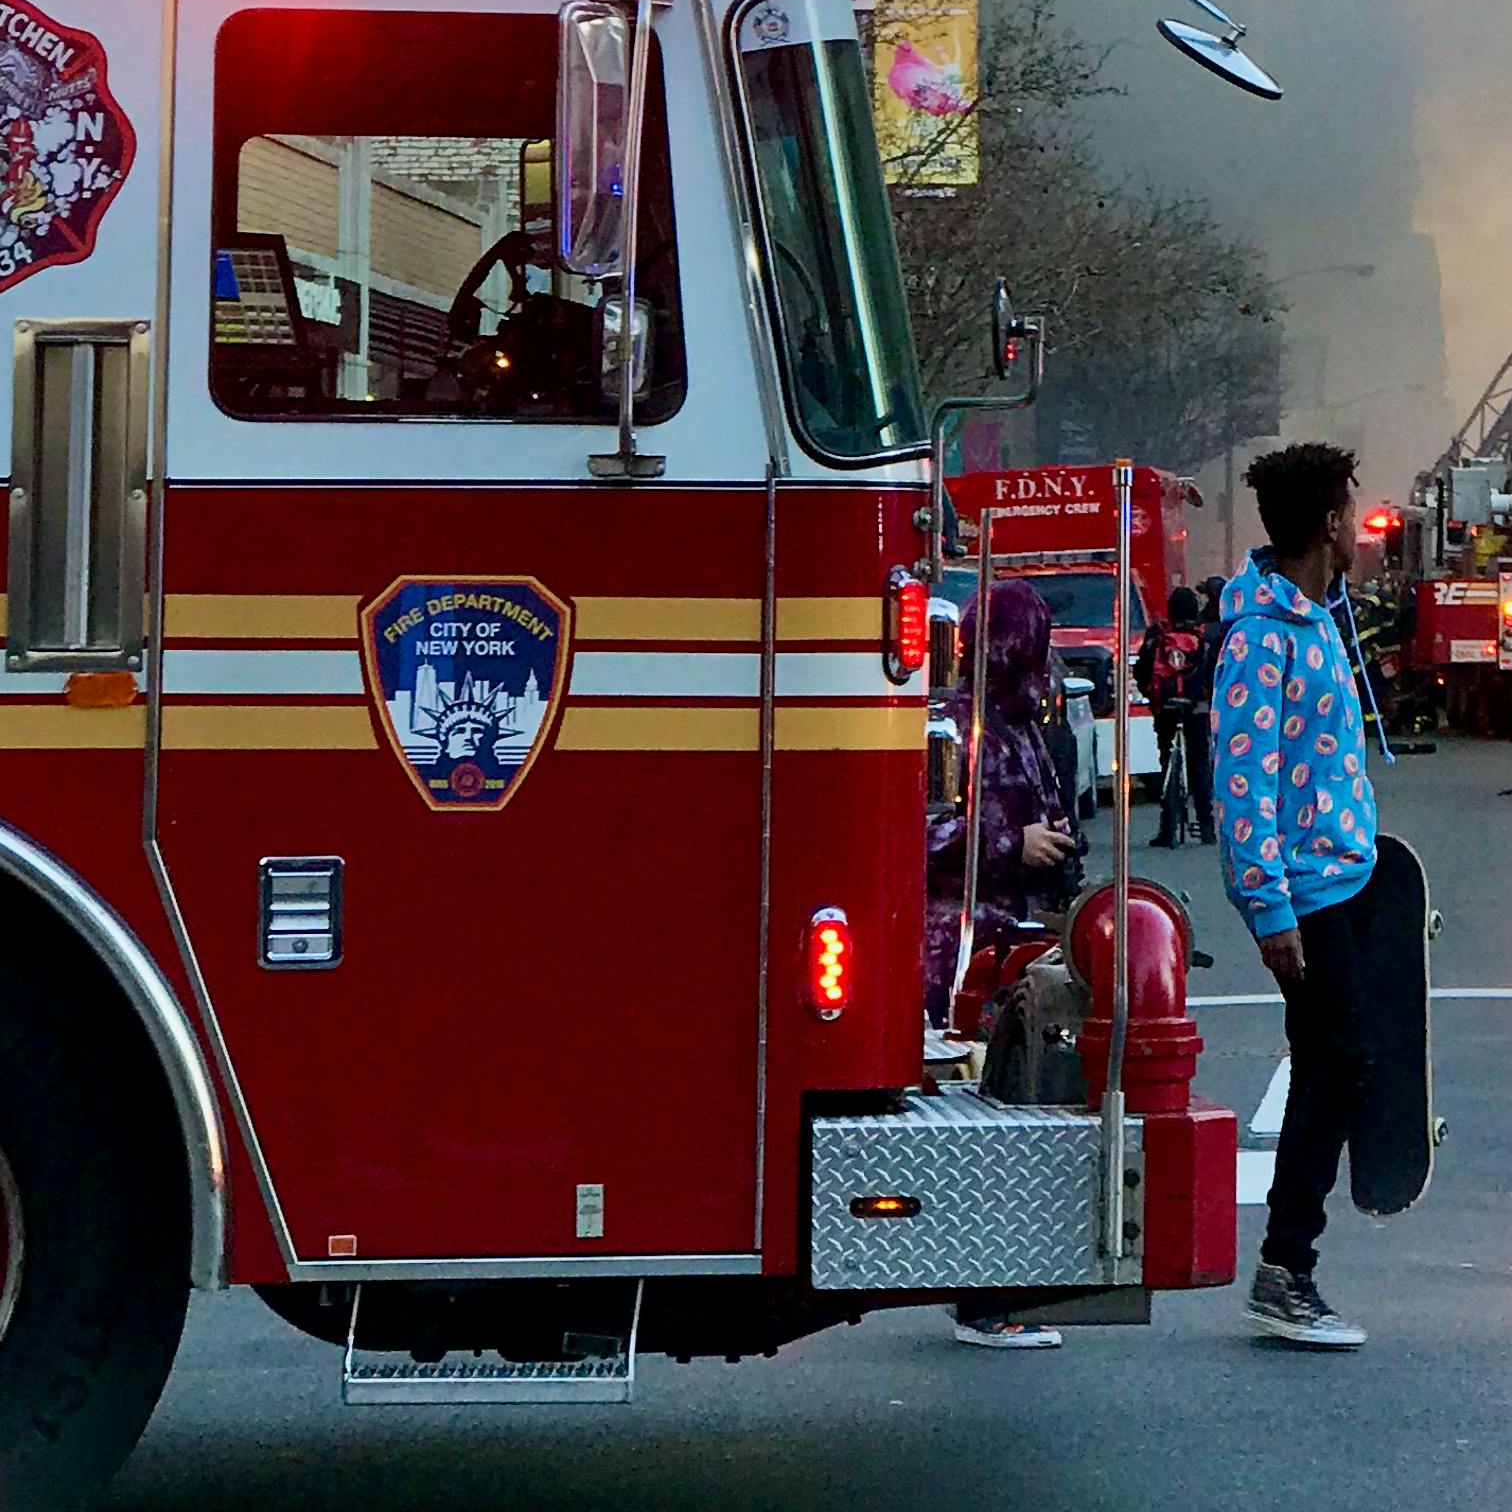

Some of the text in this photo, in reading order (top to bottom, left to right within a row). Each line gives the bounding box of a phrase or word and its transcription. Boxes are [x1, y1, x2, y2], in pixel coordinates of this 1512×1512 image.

[383, 594, 554, 643] FIRE DEPARTMENT
[430, 622, 501, 638] CITY OF
[415, 640, 516, 656] NEW YORK
